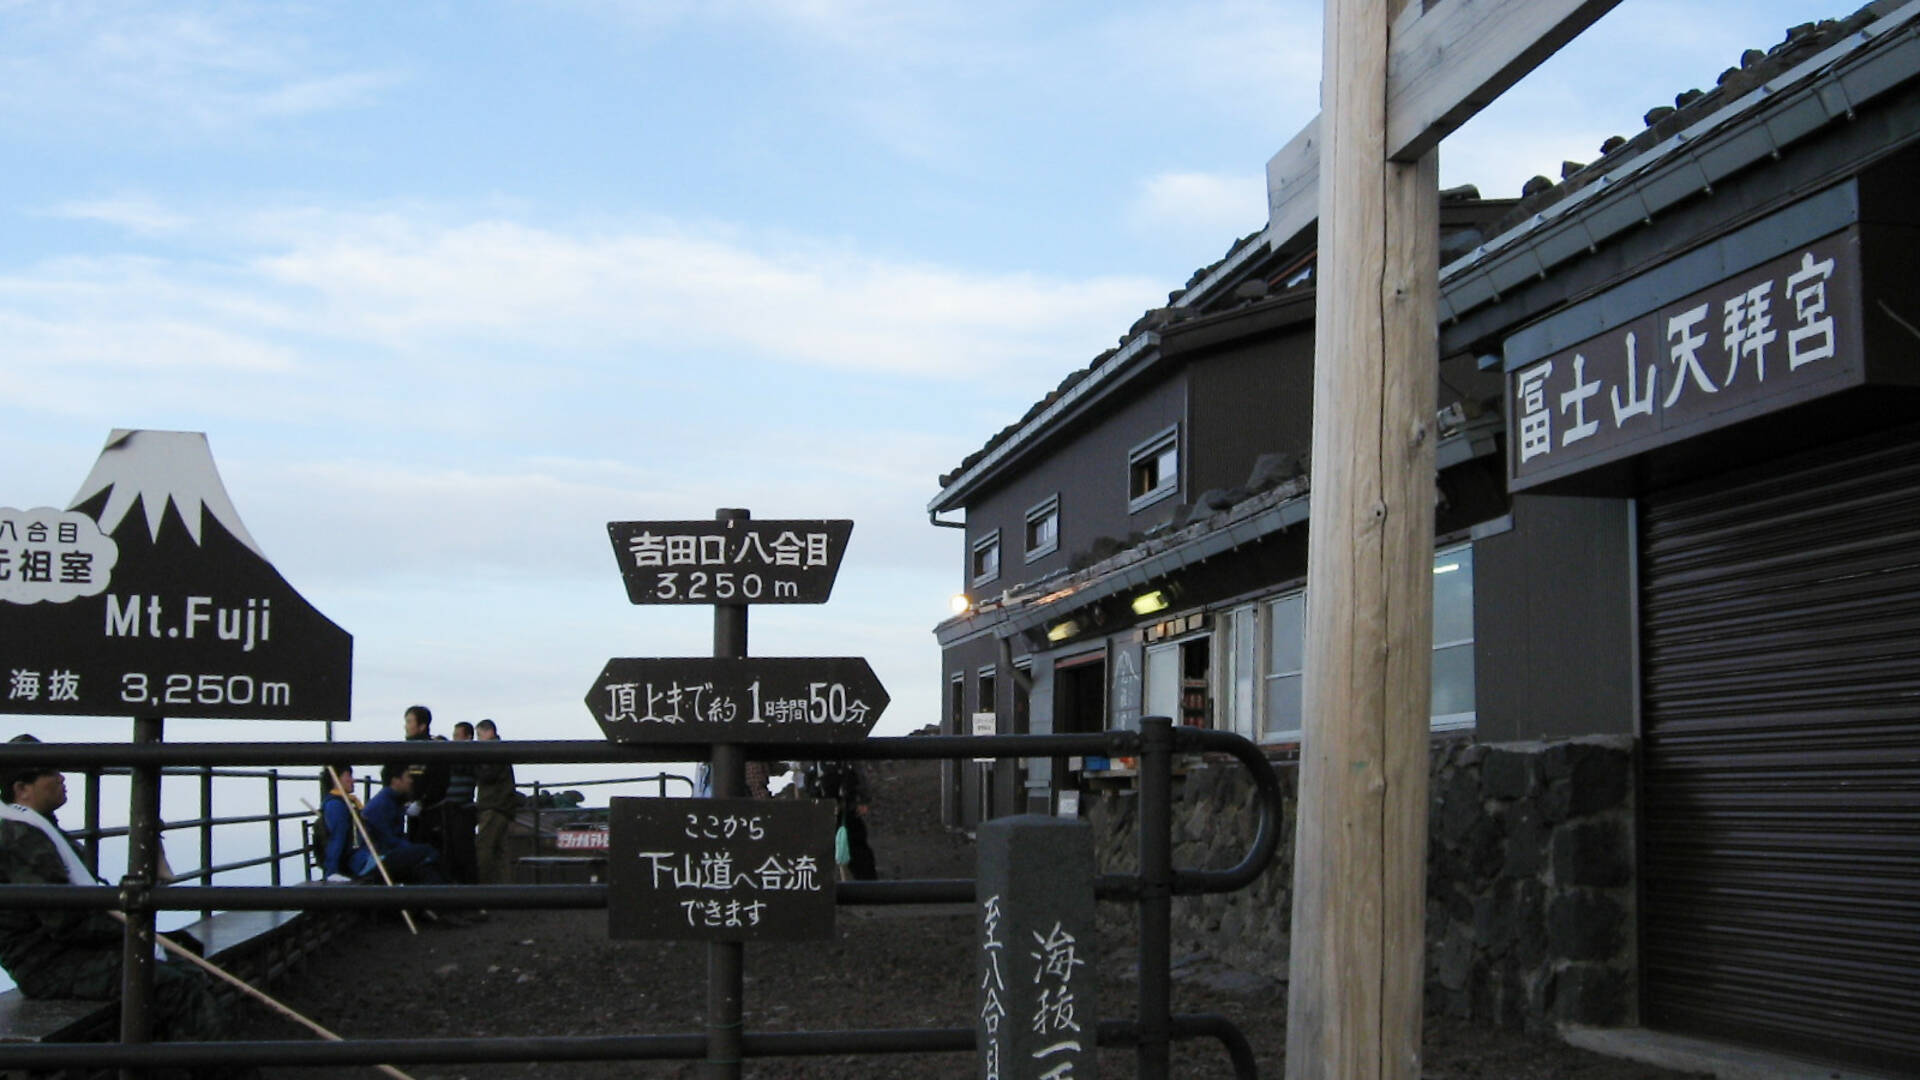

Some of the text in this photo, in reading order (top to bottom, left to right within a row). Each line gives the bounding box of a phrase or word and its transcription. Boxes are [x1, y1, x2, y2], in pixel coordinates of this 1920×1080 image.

[105, 593, 271, 651] Mt.Fuji
[9, 668, 81, 701] 海抜
[685, 813, 765, 841] ここから
[639, 851, 822, 891] 下山道へ合流
[680, 899, 767, 927] できます
